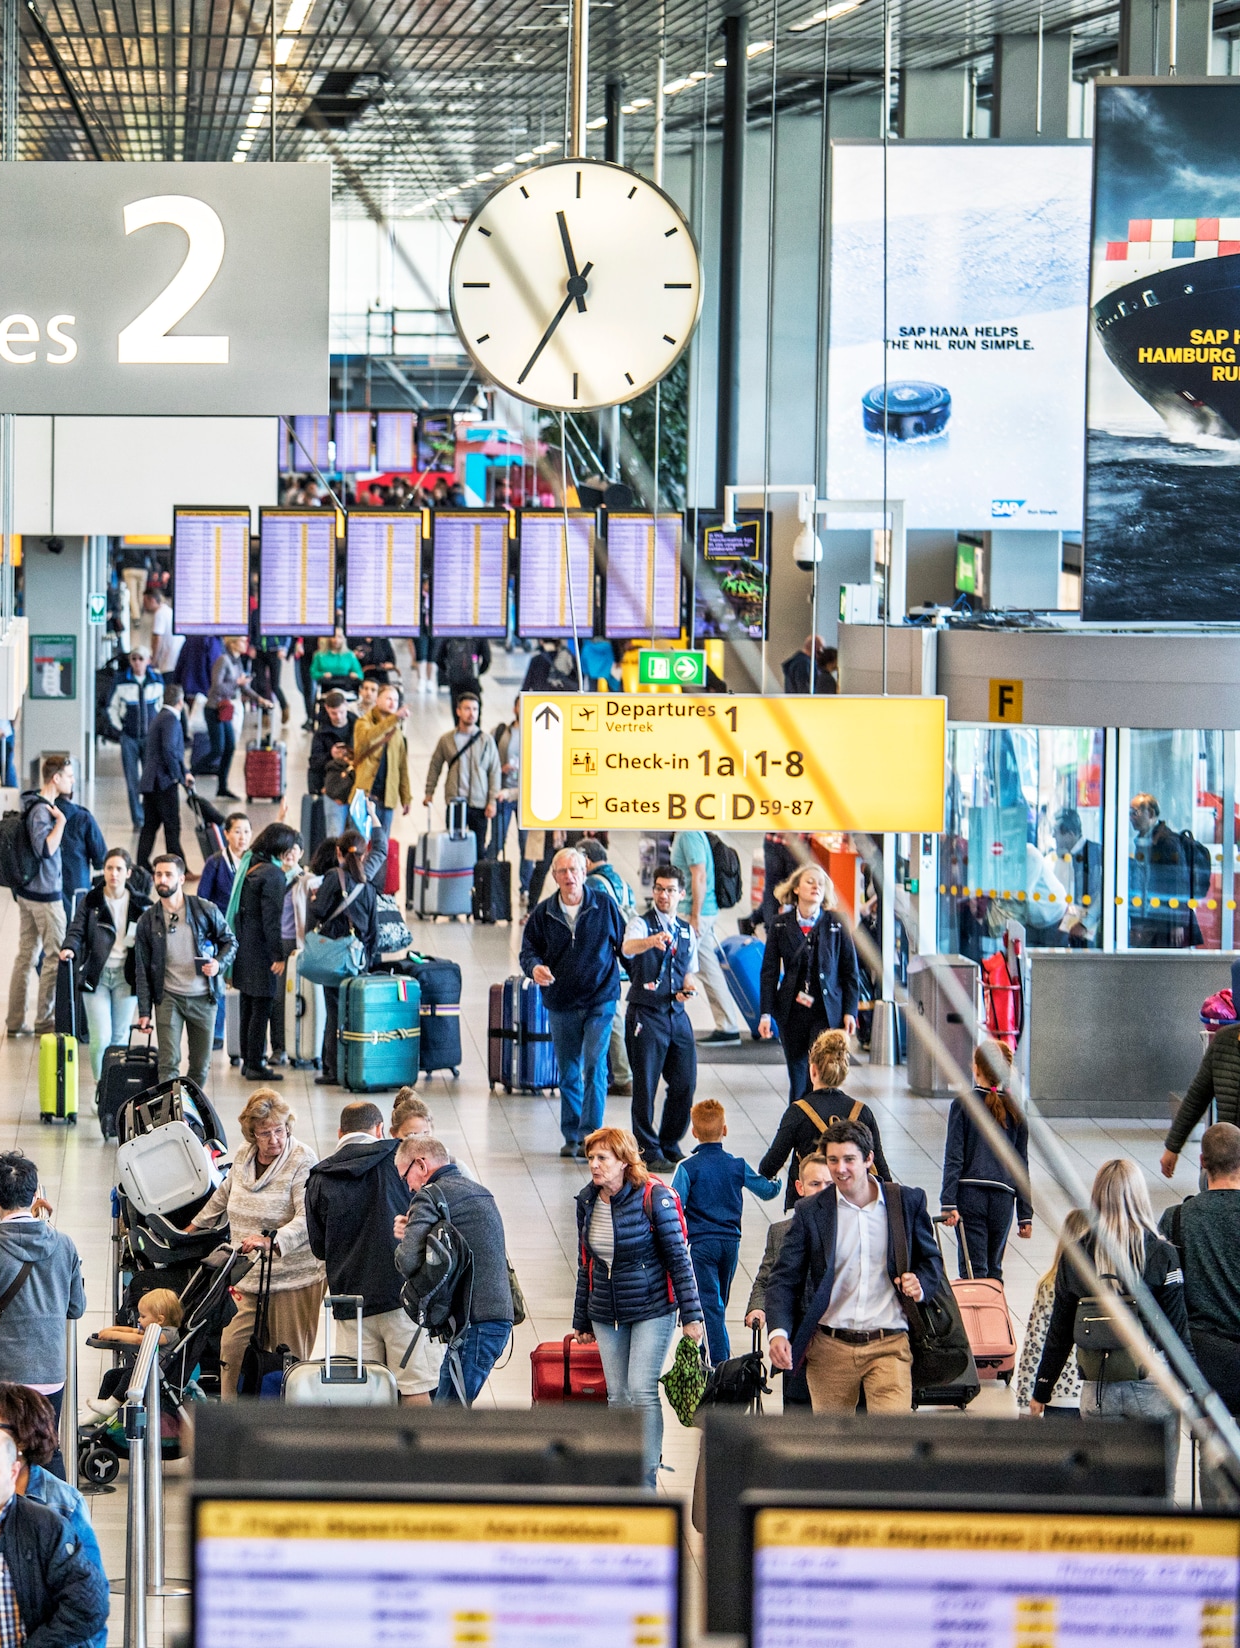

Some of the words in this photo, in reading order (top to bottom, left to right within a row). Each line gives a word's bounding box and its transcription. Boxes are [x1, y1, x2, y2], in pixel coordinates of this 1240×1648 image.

[117, 194, 231, 365] 2
[899, 326, 927, 337] SAP
[930, 326, 969, 337] HANA
[975, 326, 1019, 338] HELPS
[1190, 329, 1230, 345] SAP
[884, 339, 910, 350] THE
[914, 340, 942, 350] NHL
[948, 340, 976, 350] RUN
[981, 340, 1035, 350] SIMPLE.
[1138, 347, 1236, 364] HAMBURG
[992, 501, 1019, 514] SAP
[998, 685, 1014, 717] F
[606, 700, 717, 721] Departures
[723, 706, 739, 733] 1
[605, 721, 654, 733] Vertrek
[605, 752, 690, 771] Check-in
[697, 749, 736, 777] 1a
[754, 749, 805, 778] 1-8
[605, 797, 661, 814] Gates
[667, 794, 688, 820] B
[694, 793, 717, 821] C
[731, 794, 755, 820] D
[759, 799, 814, 816] 59-87
